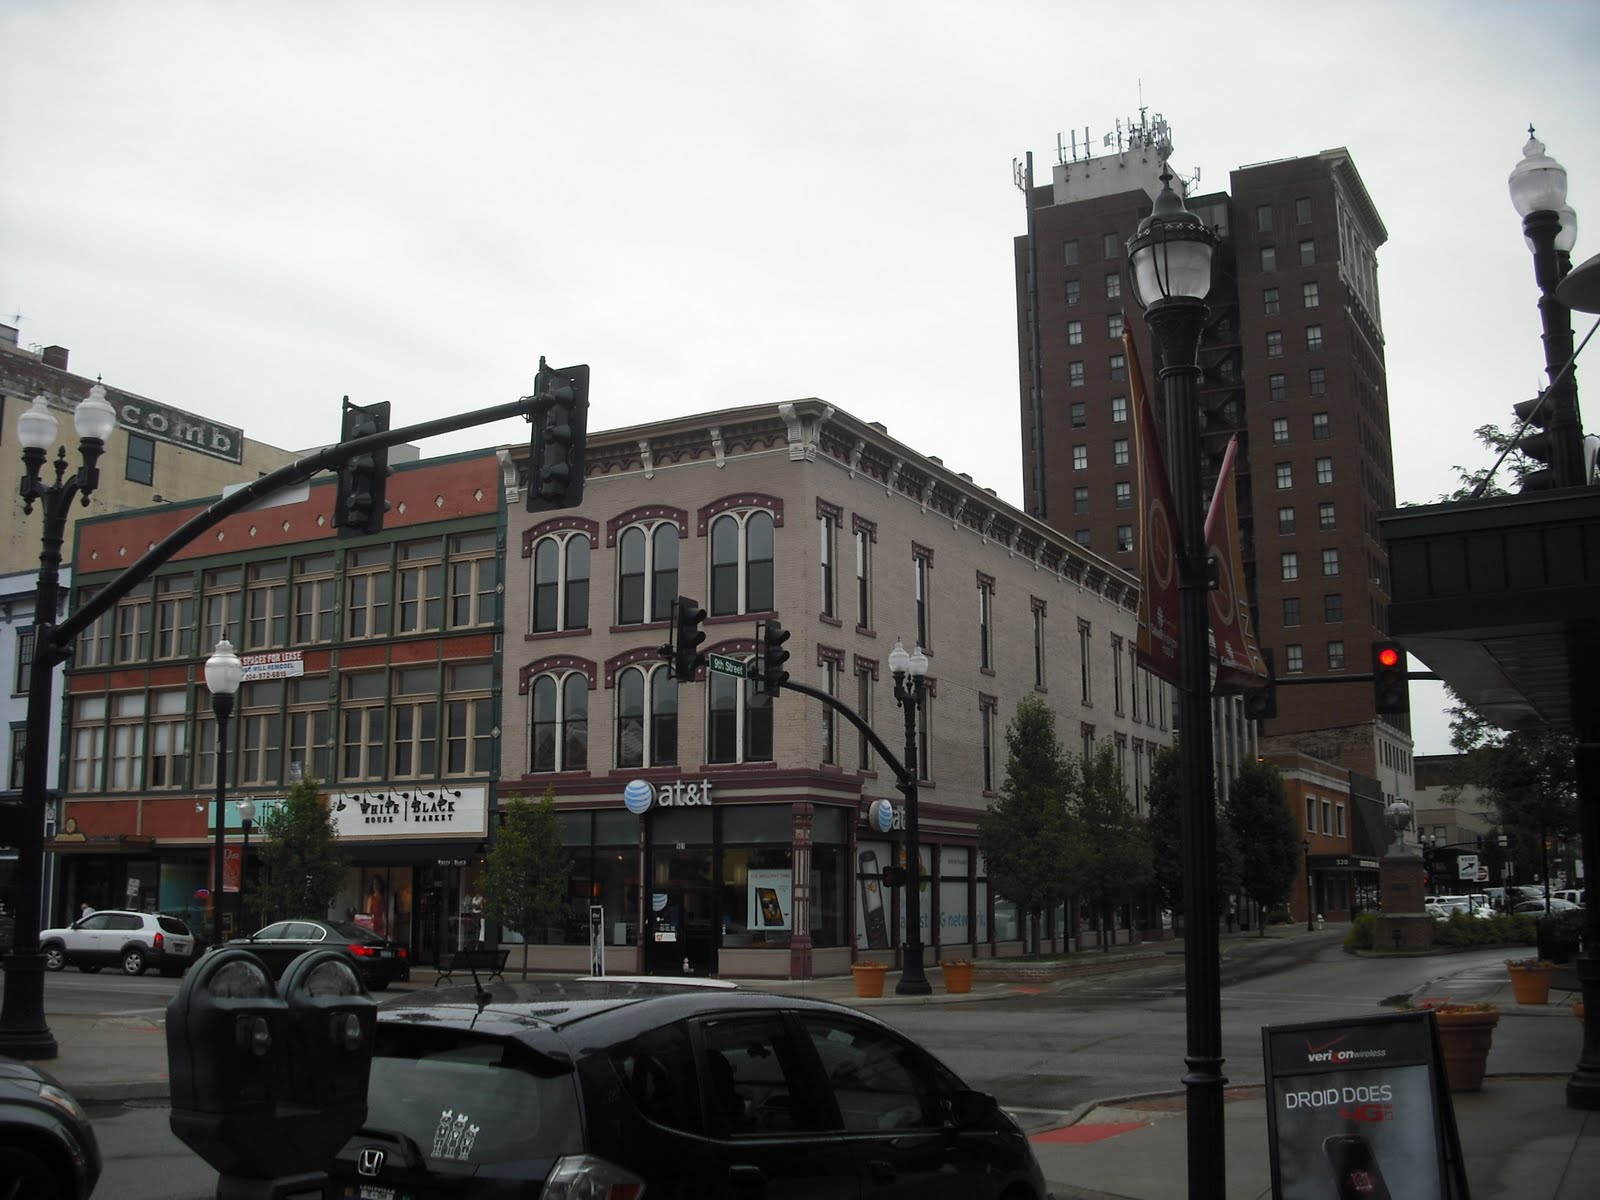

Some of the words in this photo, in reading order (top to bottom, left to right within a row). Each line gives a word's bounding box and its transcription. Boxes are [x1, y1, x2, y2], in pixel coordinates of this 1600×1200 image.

[242, 654, 266, 665] SPACES
[267, 653, 281, 663] FOR
[281, 651, 302, 662] LEASE
[714, 658, 725, 670] 9th
[725, 661, 743, 675] Street
[658, 779, 712, 806] at&t
[360, 803, 400, 815] WHITE
[415, 814, 453, 822] MARKET
[1285, 1089, 1339, 1109] DROID
[1342, 1085, 1392, 1103] DOES
